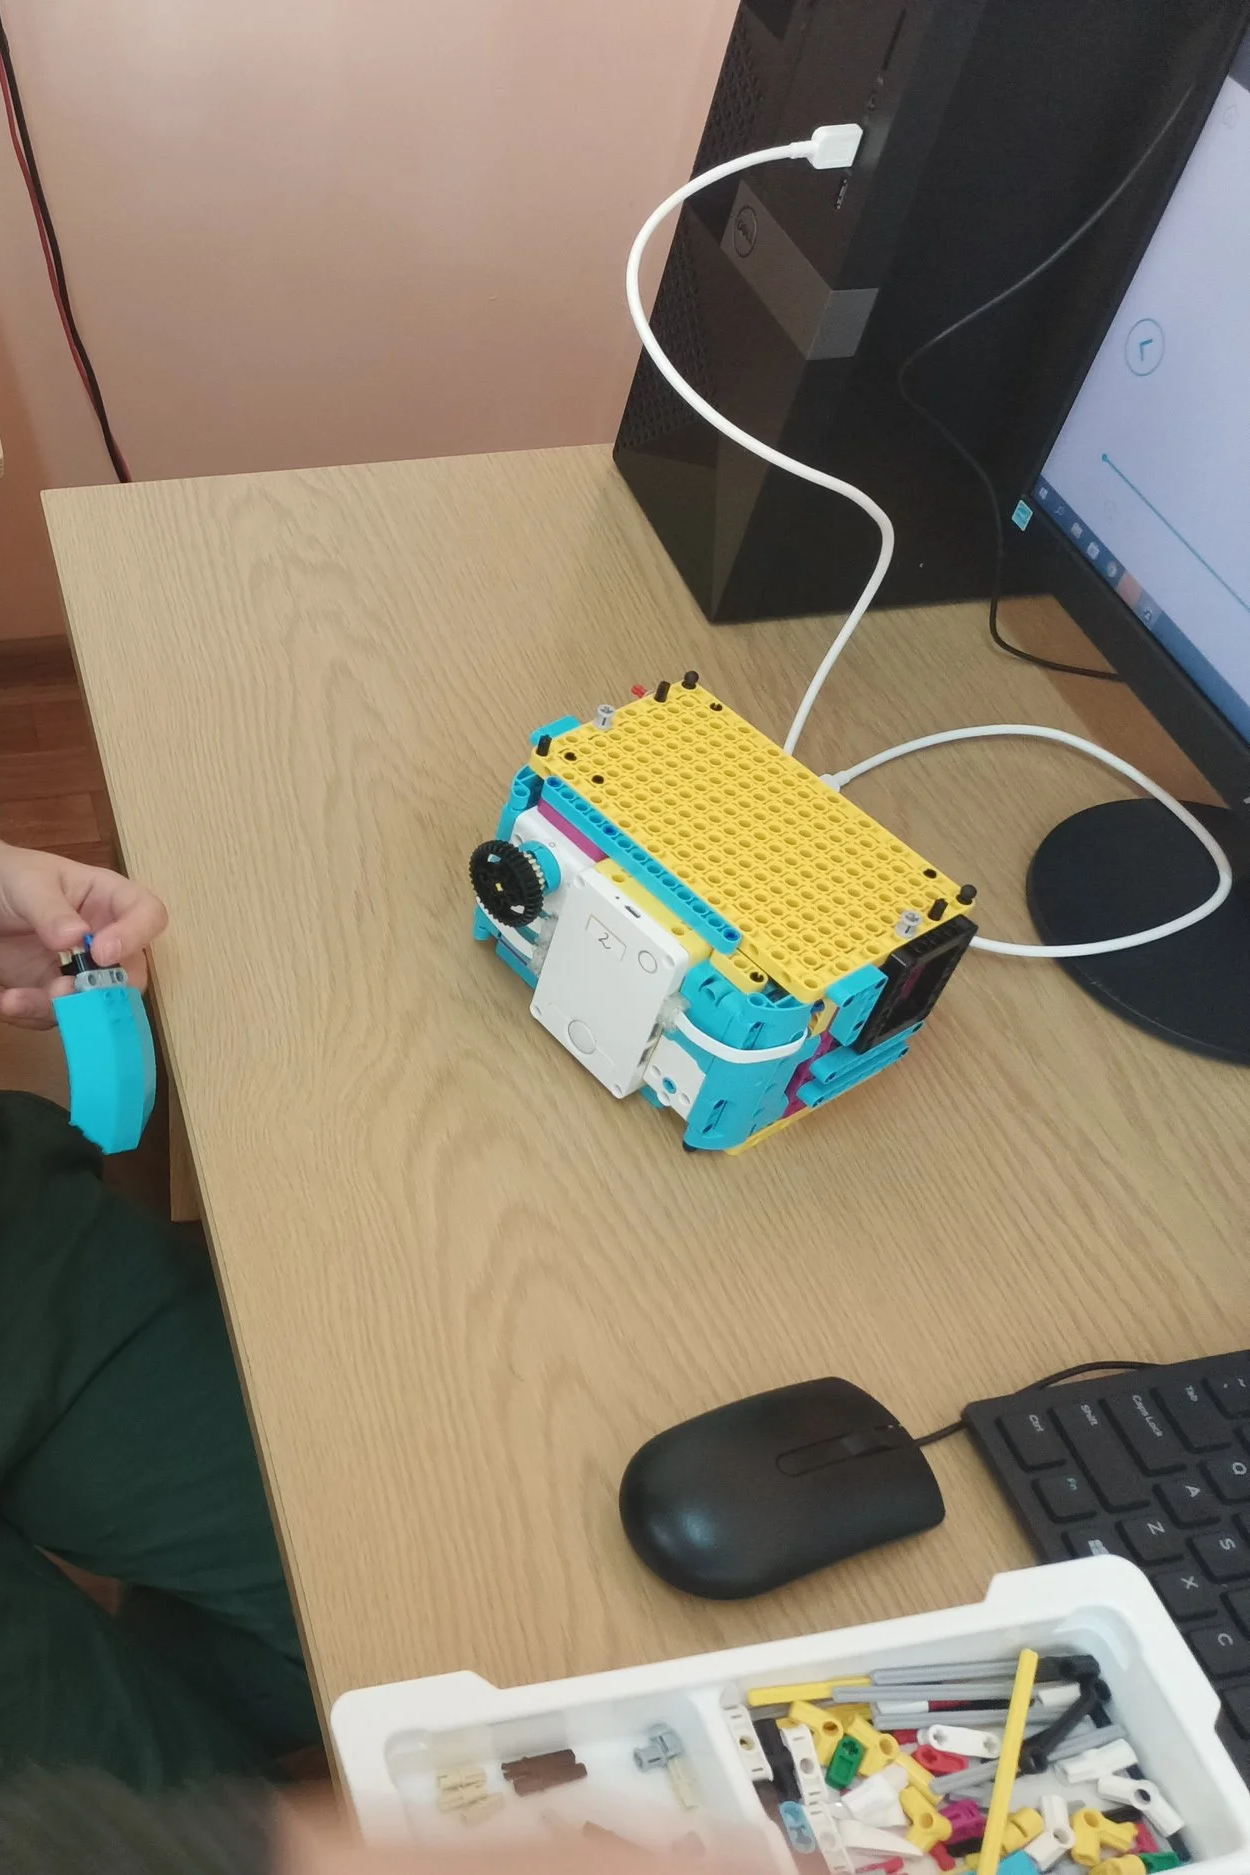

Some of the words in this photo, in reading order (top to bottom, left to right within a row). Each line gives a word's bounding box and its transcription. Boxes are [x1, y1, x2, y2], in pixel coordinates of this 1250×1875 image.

[1080, 1404, 1098, 1426] Shift
[1029, 1414, 1045, 1432] Ctrl
[1185, 1485, 1201, 1498] A
[1147, 1521, 1166, 1535] Z
[1219, 1537, 1237, 1551] S
[1181, 1575, 1199, 1590] X
[1217, 1632, 1234, 1646] C
